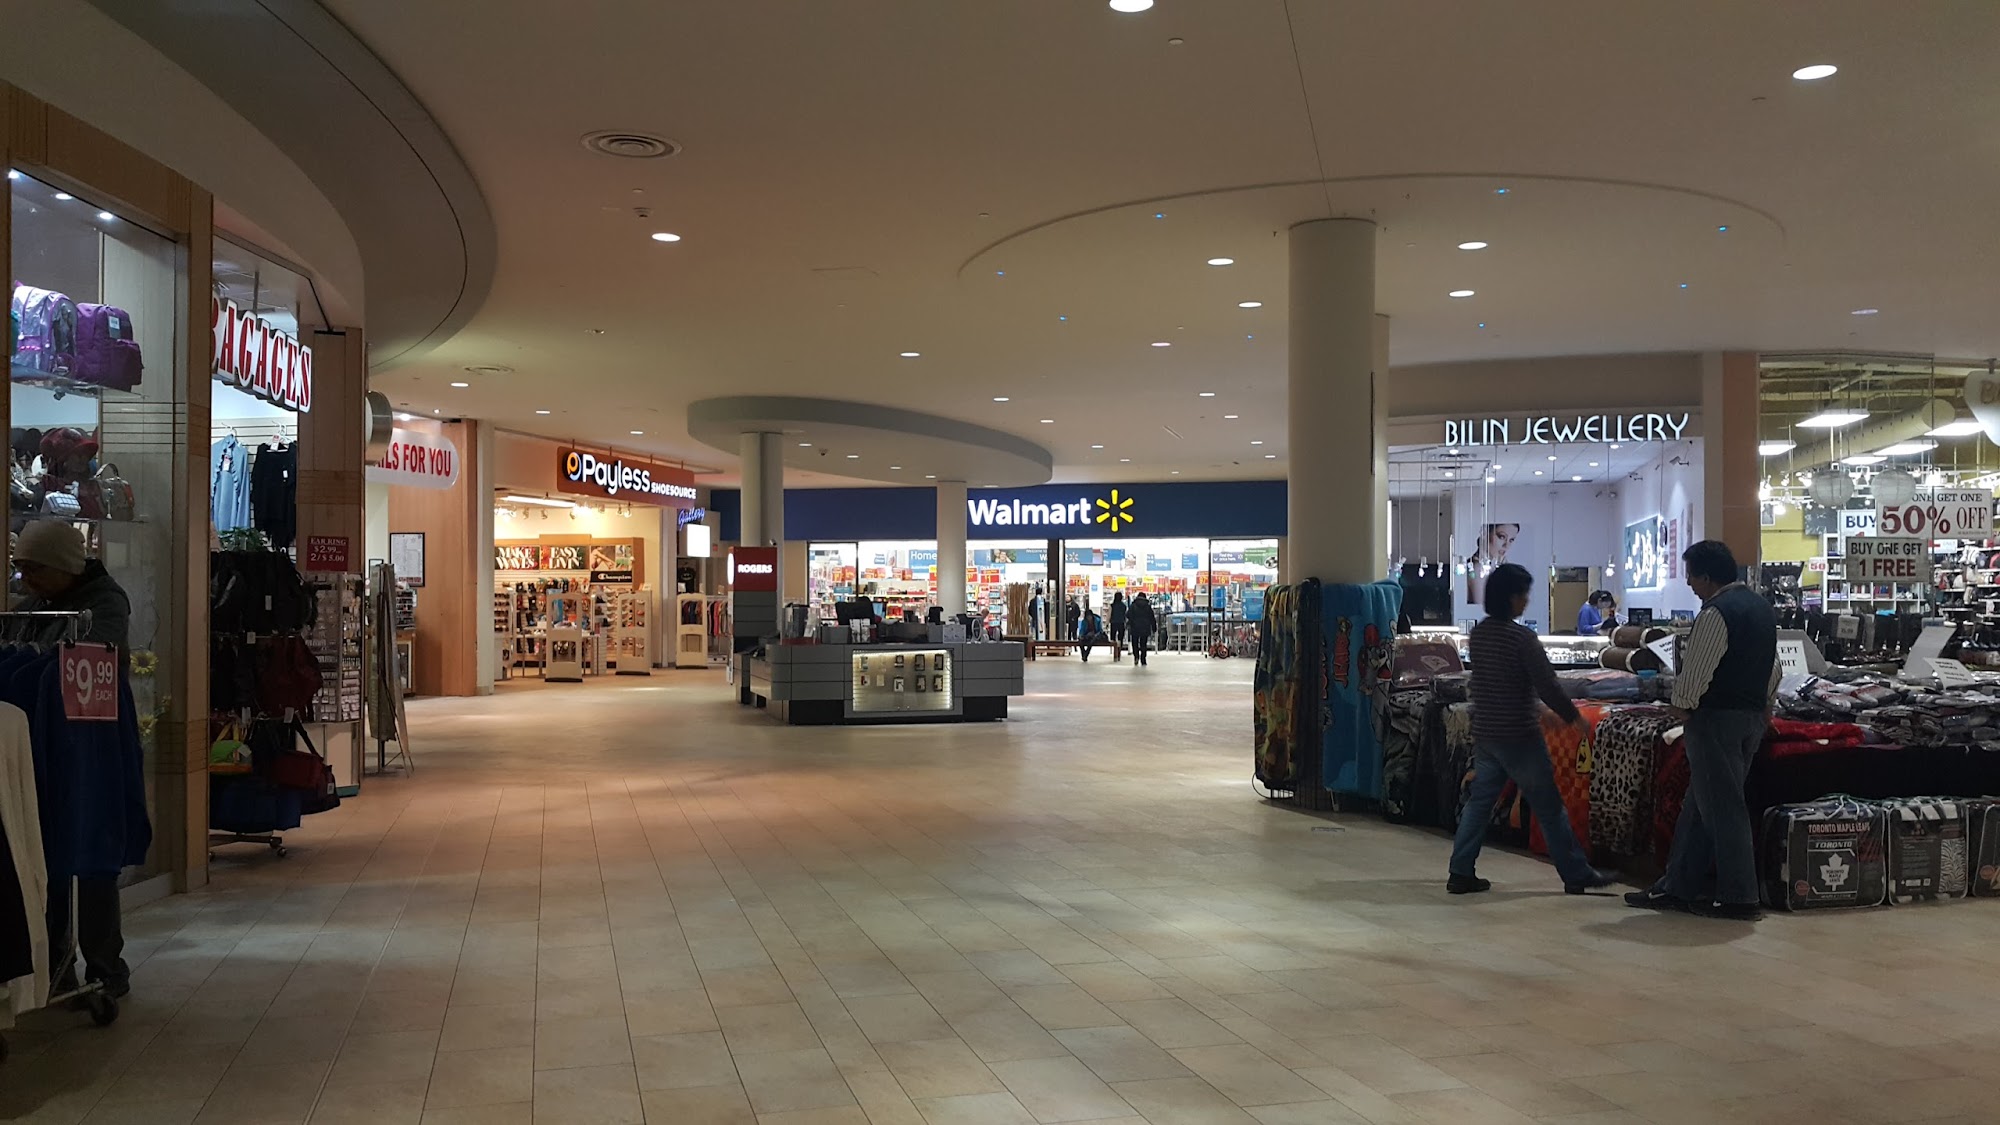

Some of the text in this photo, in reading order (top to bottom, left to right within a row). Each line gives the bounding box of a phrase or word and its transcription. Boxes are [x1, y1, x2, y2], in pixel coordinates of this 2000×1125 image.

[1445, 412, 1689, 447] BILIN JEWELLERY
[403, 444, 426, 474] FOR
[429, 448, 451, 477] YOU
[582, 454, 697, 499] Payless SHOESOURCE
[1912, 493, 1983, 502] ONE GET ONE
[967, 498, 1092, 526] Walmart
[1846, 515, 1877, 528] BUY
[1881, 505, 1988, 534] 50% OFF
[498, 547, 533, 558] MAKE
[550, 546, 580, 558] EASY
[1851, 542, 1922, 555] BUY ONE GET
[910, 551, 937, 560] Home
[496, 556, 535, 570] WAVES
[737, 564, 773, 573] ROGERS
[1859, 559, 1916, 576] 1 FREE
[597, 573, 632, 581] Champion
[96, 689, 112, 701] EACH
[1808, 823, 1836, 833] TORONTO
[1836, 823, 1855, 833] MAPLE
